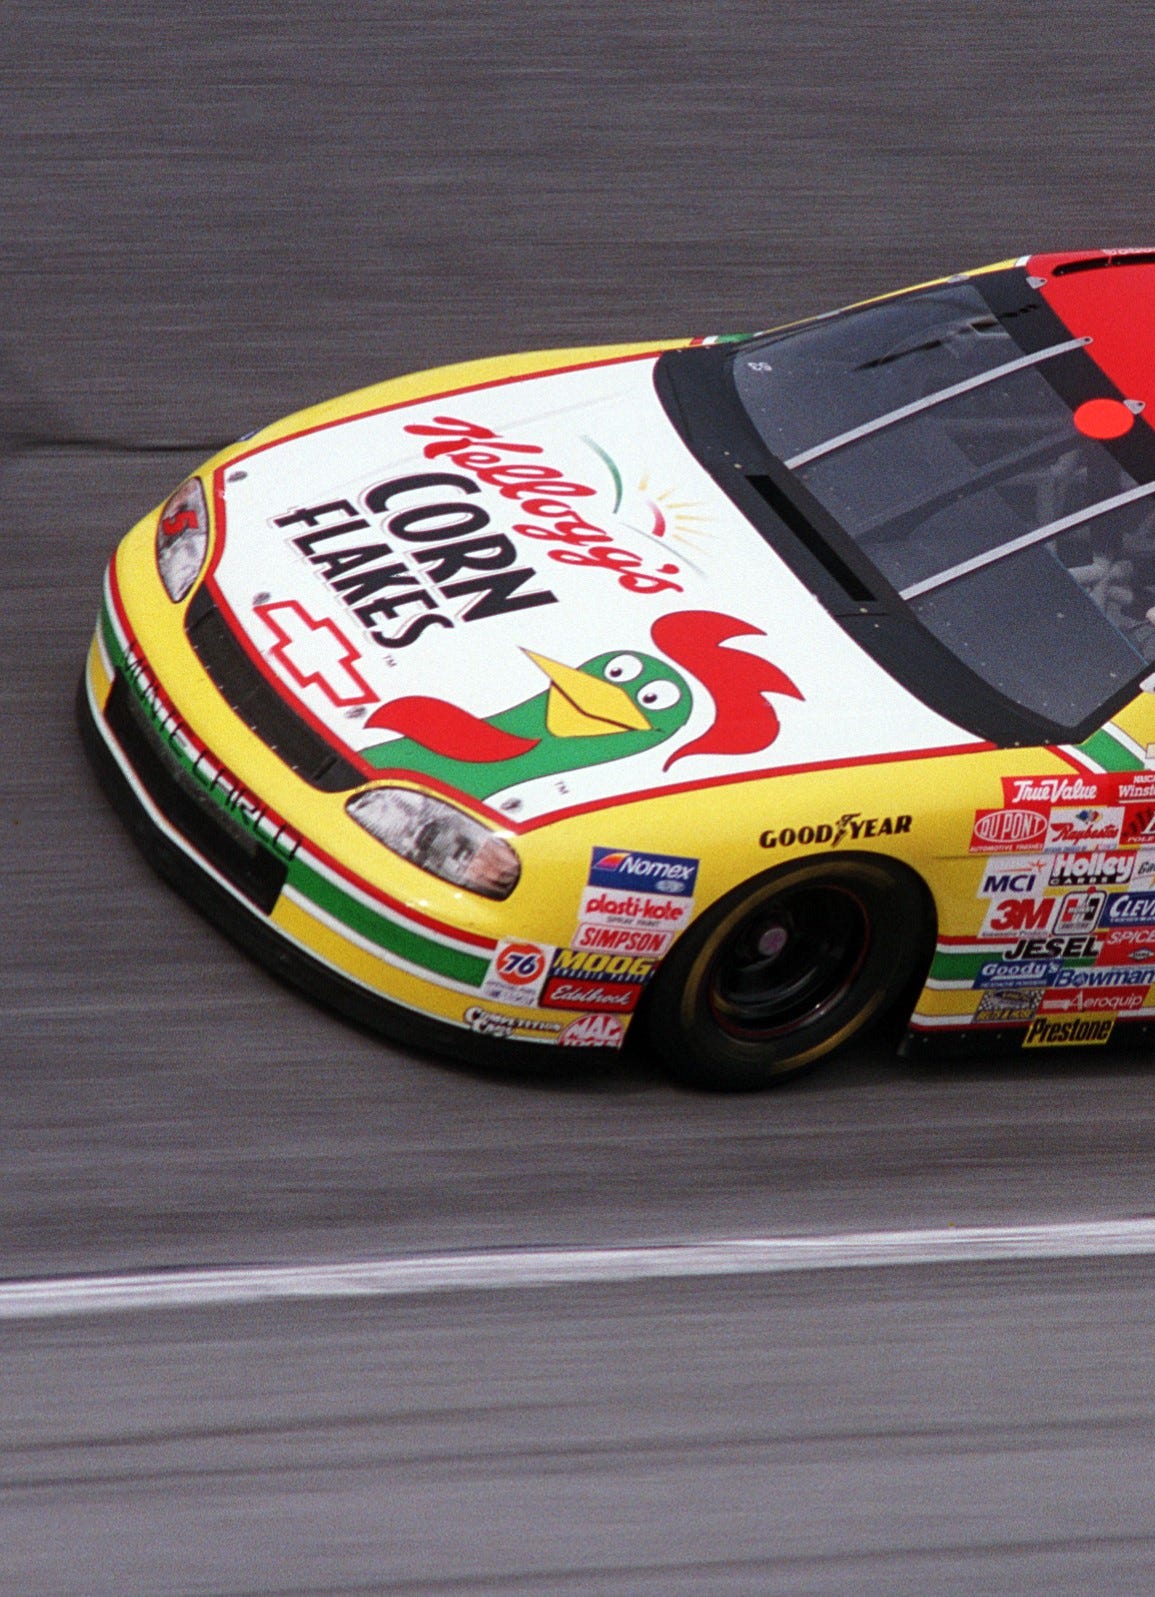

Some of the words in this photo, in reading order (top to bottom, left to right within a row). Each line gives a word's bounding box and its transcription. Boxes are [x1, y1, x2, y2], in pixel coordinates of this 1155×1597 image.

[403, 416, 684, 594] Kellogg's
[363, 472, 560, 623] CORN
[273, 500, 455, 648] FLAKES
[619, 856, 695, 879] Nomex
[1052, 851, 1135, 883] Holley
[983, 875, 1035, 893] MCI
[585, 893, 684, 921] plasti-kote
[990, 897, 1056, 930] 3M
[579, 926, 667, 952] SIMPSON
[1004, 937, 1101, 960] JESEL
[503, 953, 539, 977] 76
[553, 949, 656, 977] MOOG
[981, 961, 1061, 979] Goody's
[1055, 967, 1155, 988] Bowman
[551, 984, 634, 1006] Edelbrock
[1068, 990, 1143, 1012] Aeroquip
[1027, 1016, 1112, 1043] Prestone
